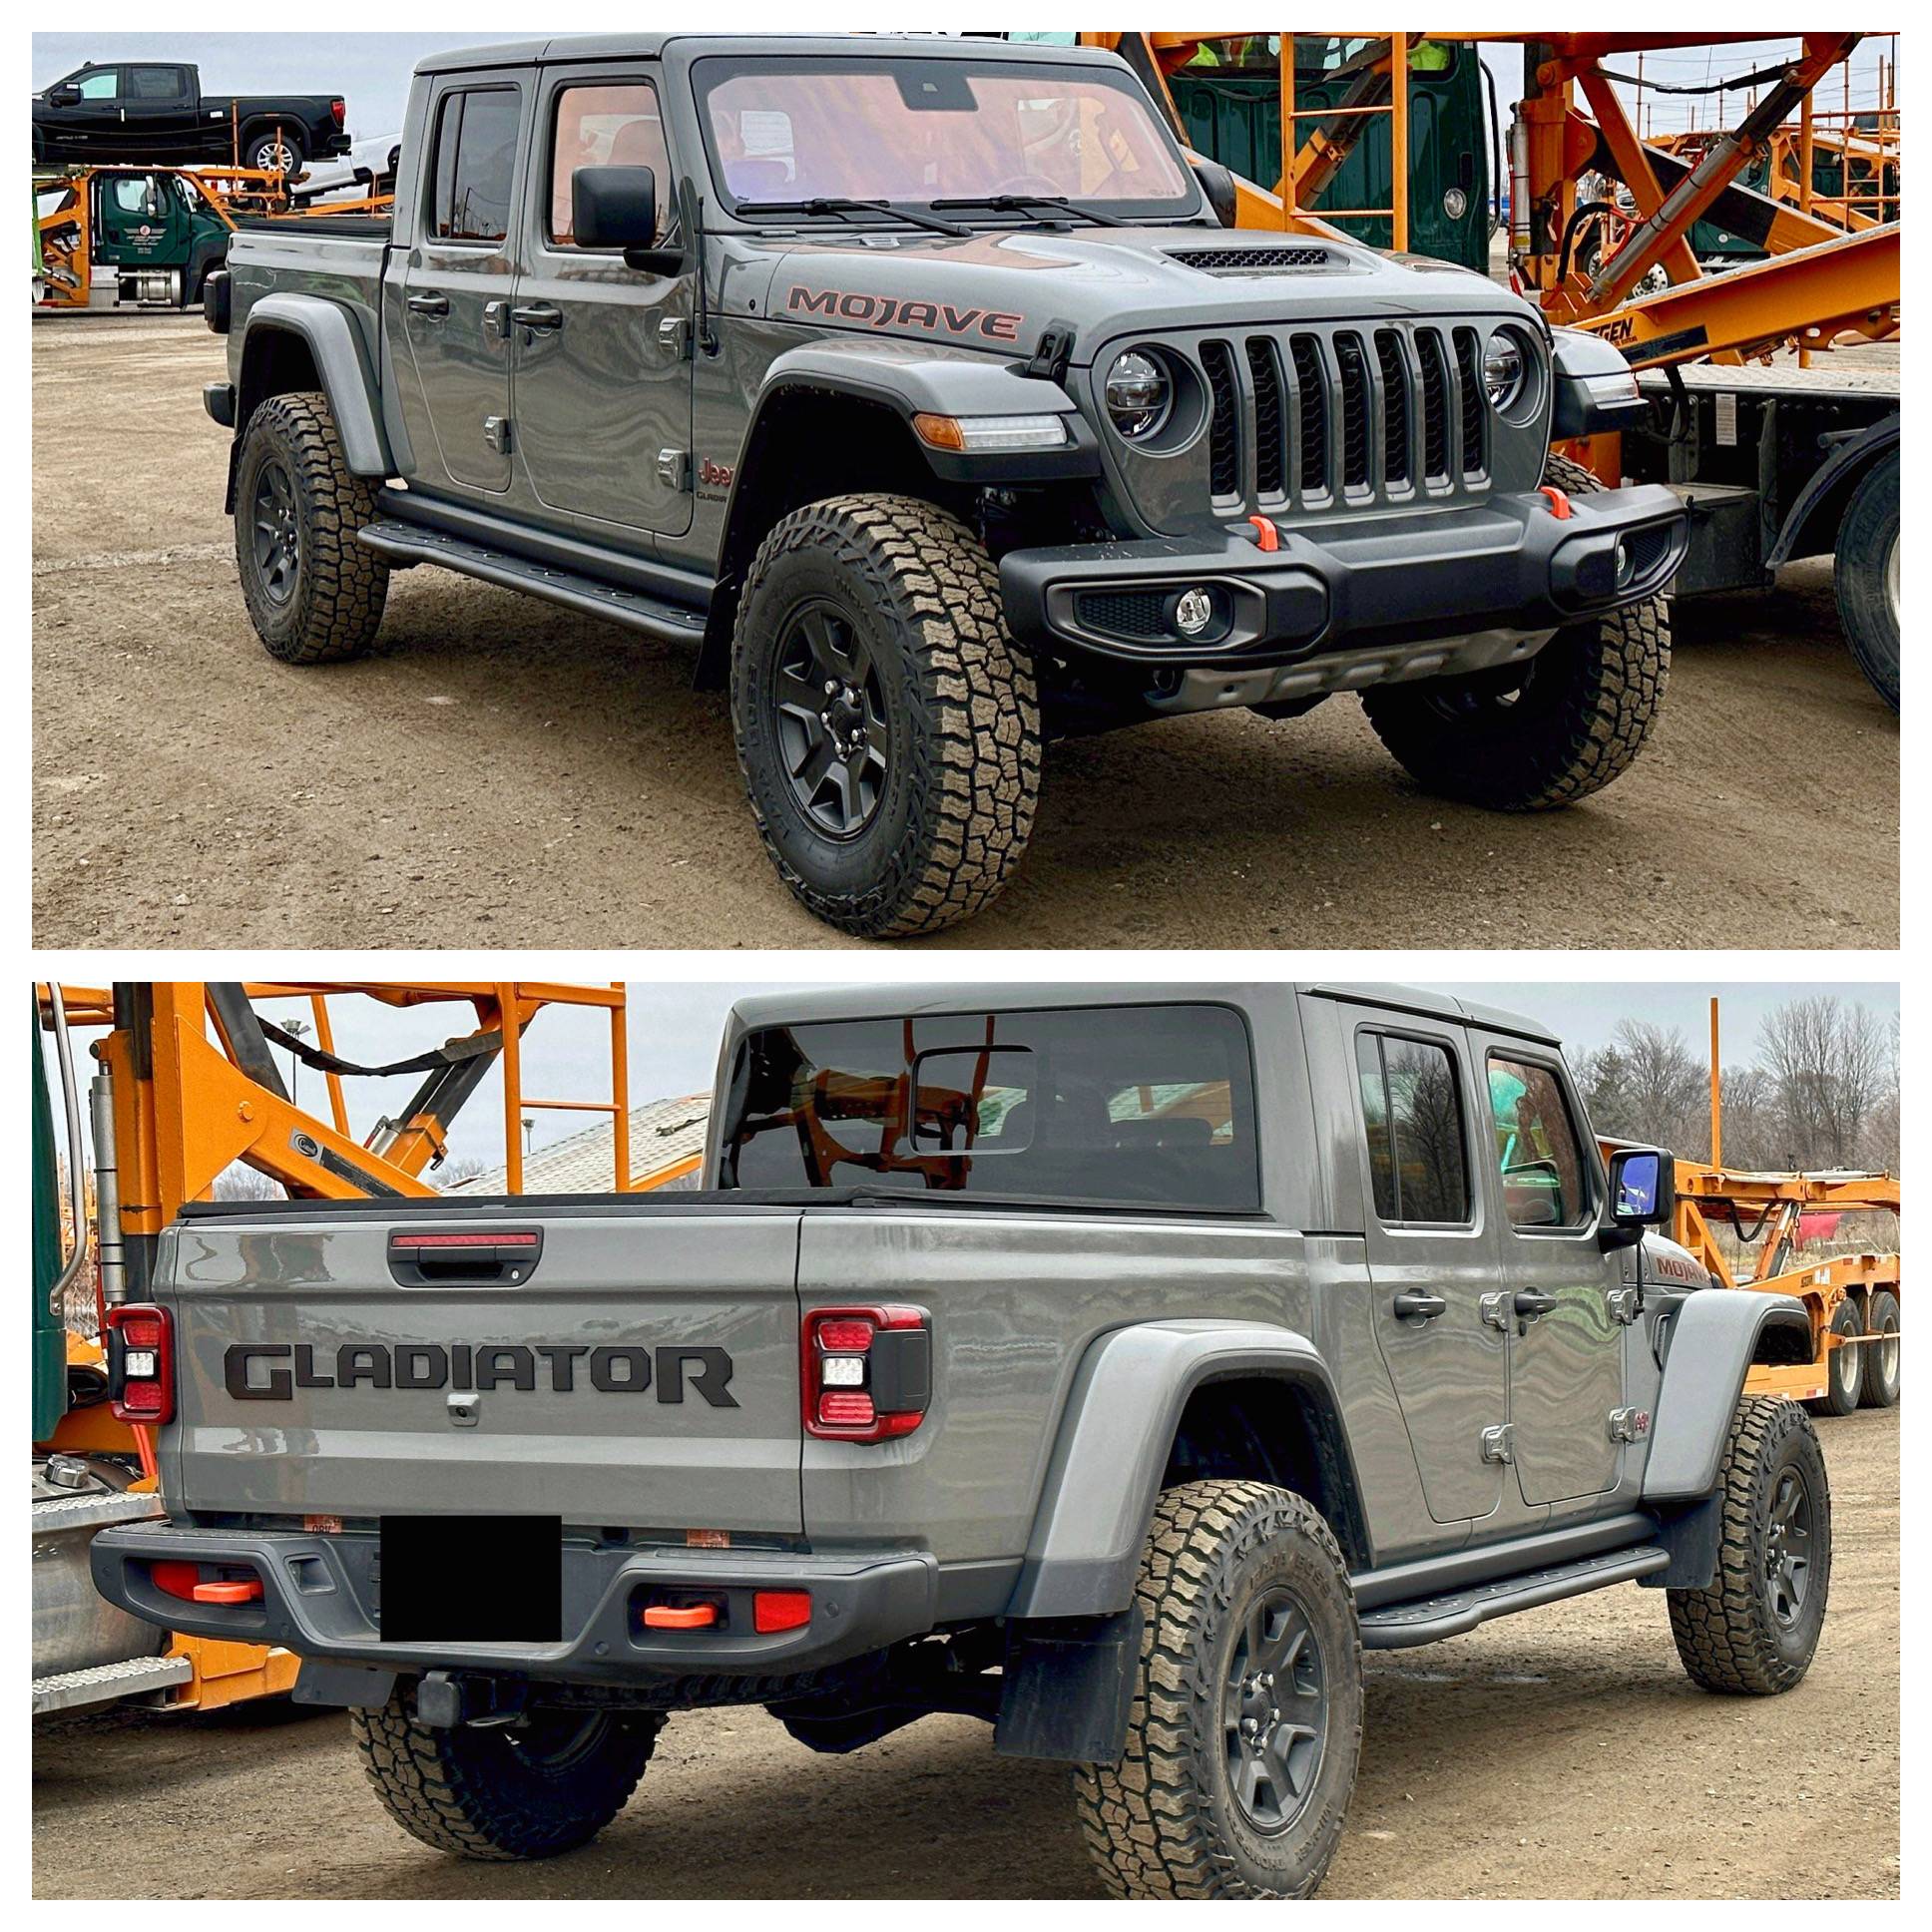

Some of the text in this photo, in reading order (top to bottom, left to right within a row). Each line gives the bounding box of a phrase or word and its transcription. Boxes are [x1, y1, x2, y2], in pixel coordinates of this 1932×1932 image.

[787, 285, 1025, 342] MOJAVE
[1586, 316, 1635, 341] GEN
[224, 1343, 741, 1408] GLADIATOR
